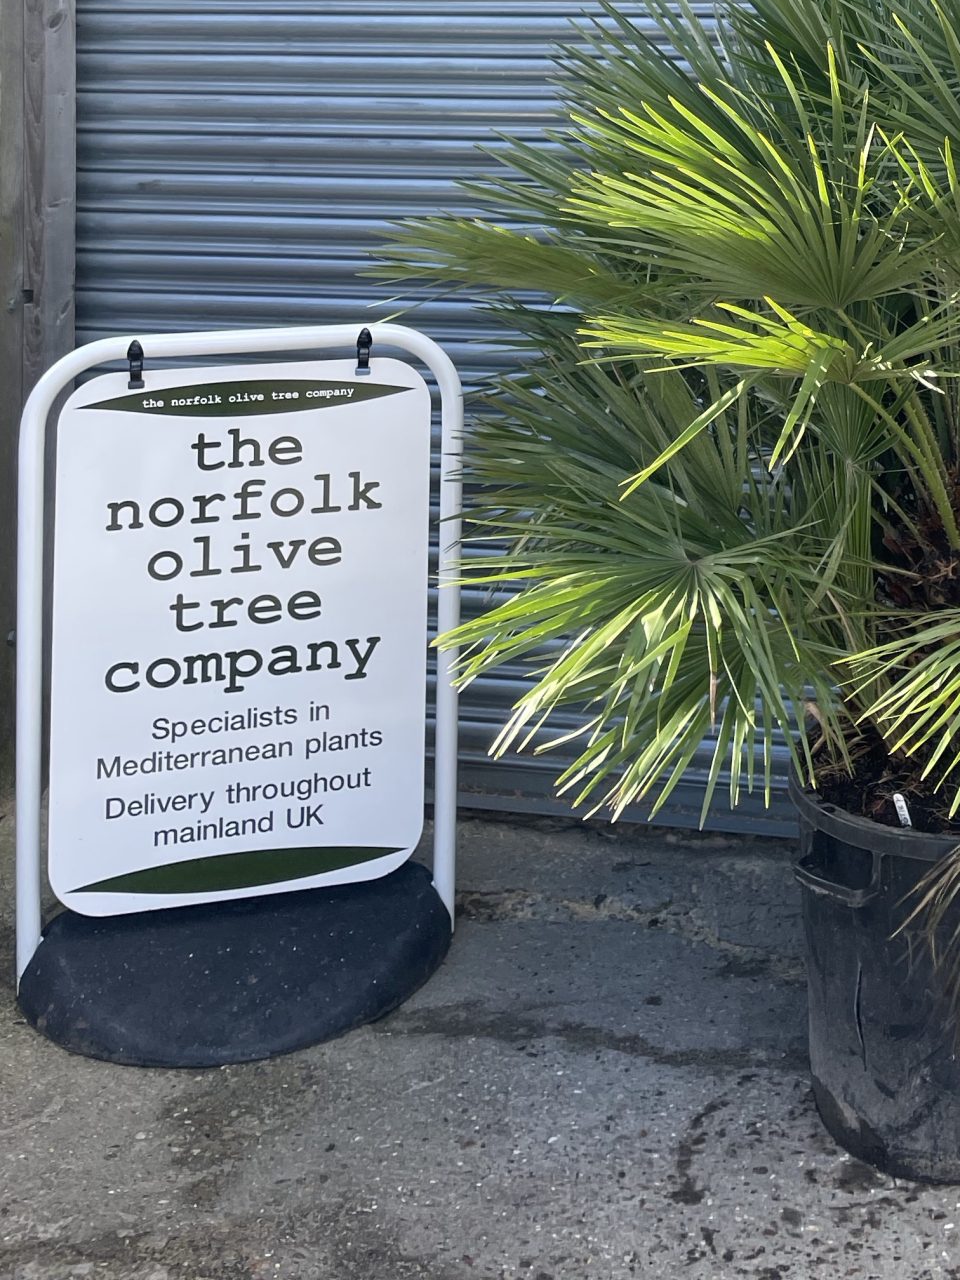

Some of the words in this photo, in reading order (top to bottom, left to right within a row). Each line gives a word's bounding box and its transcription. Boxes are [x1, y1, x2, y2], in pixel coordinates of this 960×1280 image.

[142, 398, 165, 409] the
[170, 394, 222, 407] norfolk
[228, 392, 265, 403] olive
[271, 391, 300, 400] tree
[305, 387, 355, 399] company
[190, 428, 303, 472] the
[105, 471, 383, 532] norfolk
[147, 532, 342, 581] olive
[169, 590, 322, 633] tree
[104, 636, 382, 694] company
[151, 705, 298, 744] Specialists
[309, 700, 330, 722] in
[96, 740, 293, 780] Mediterranean
[305, 727, 383, 758] plants
[105, 790, 215, 820] Delivery
[225, 767, 372, 805] throughout
[153, 810, 274, 847] mainland
[286, 803, 325, 829] UK
